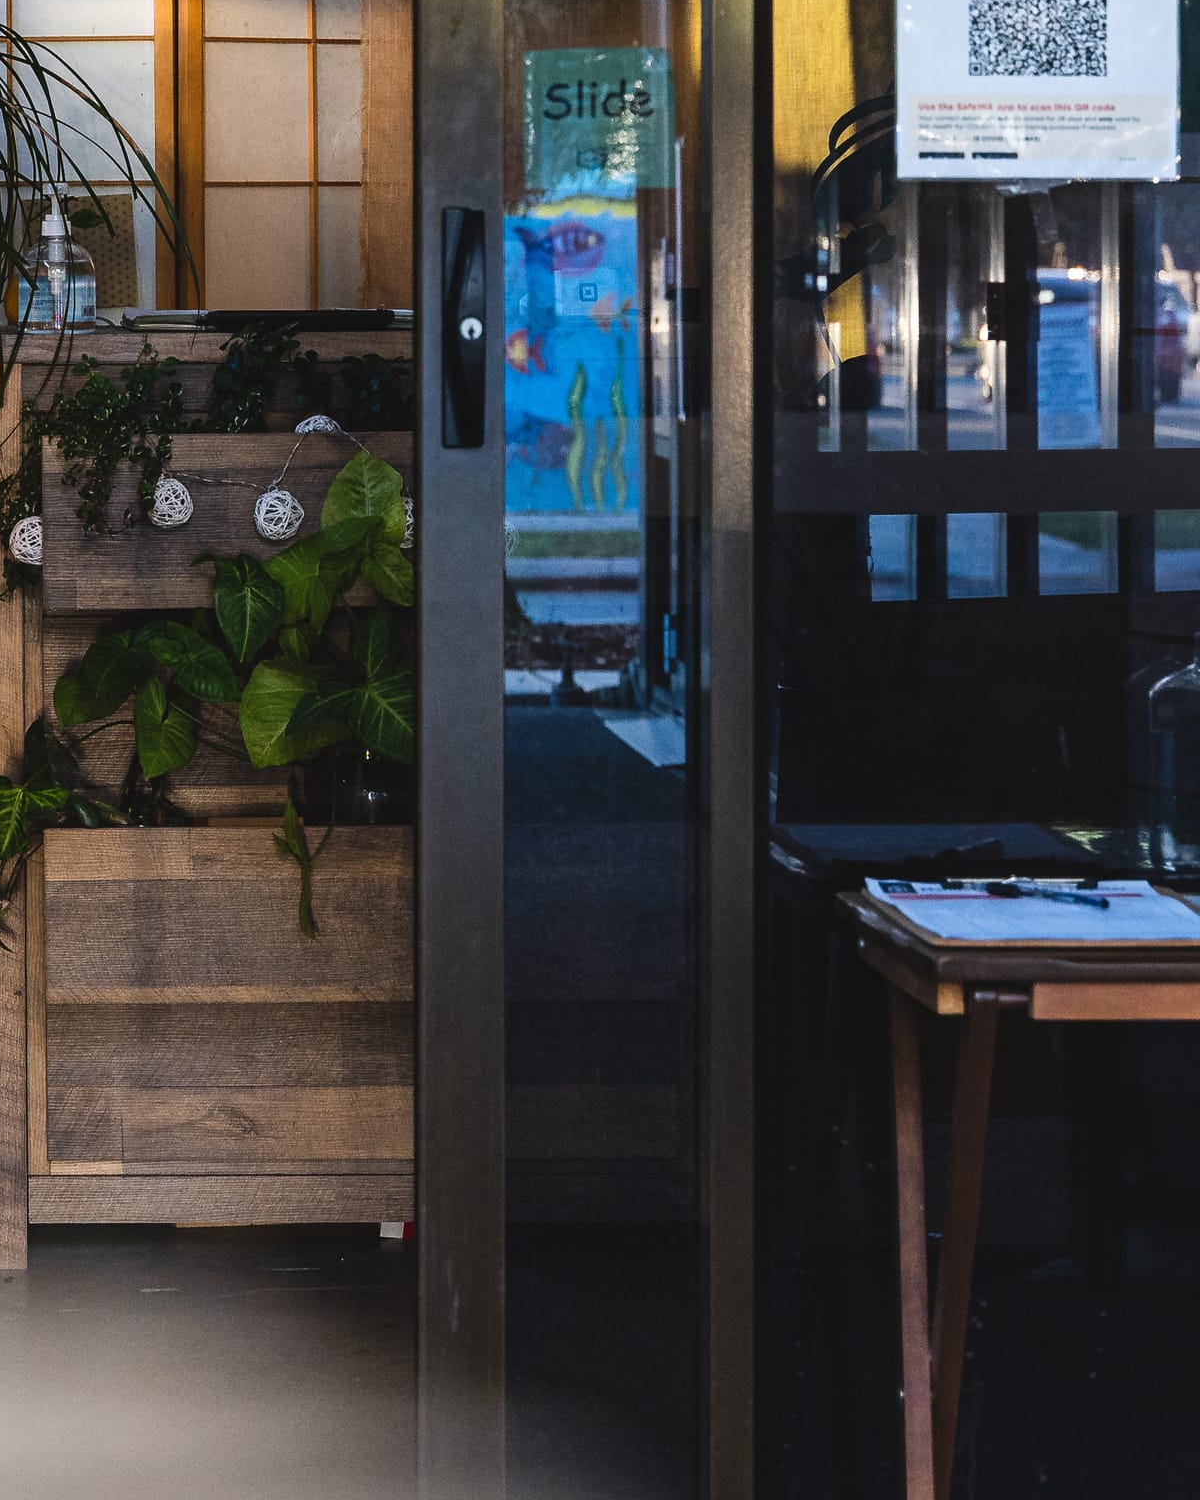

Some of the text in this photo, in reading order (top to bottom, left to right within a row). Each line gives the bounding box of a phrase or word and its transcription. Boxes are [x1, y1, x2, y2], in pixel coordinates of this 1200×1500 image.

[543, 79, 654, 120] Slide
[918, 103, 936, 111] Use
[938, 103, 954, 111] the
[1017, 103, 1028, 111] to
[1030, 104, 1052, 112] scan
[1054, 103, 1072, 112] this
[1074, 103, 1089, 112] QR
[1092, 103, 1116, 112] code
